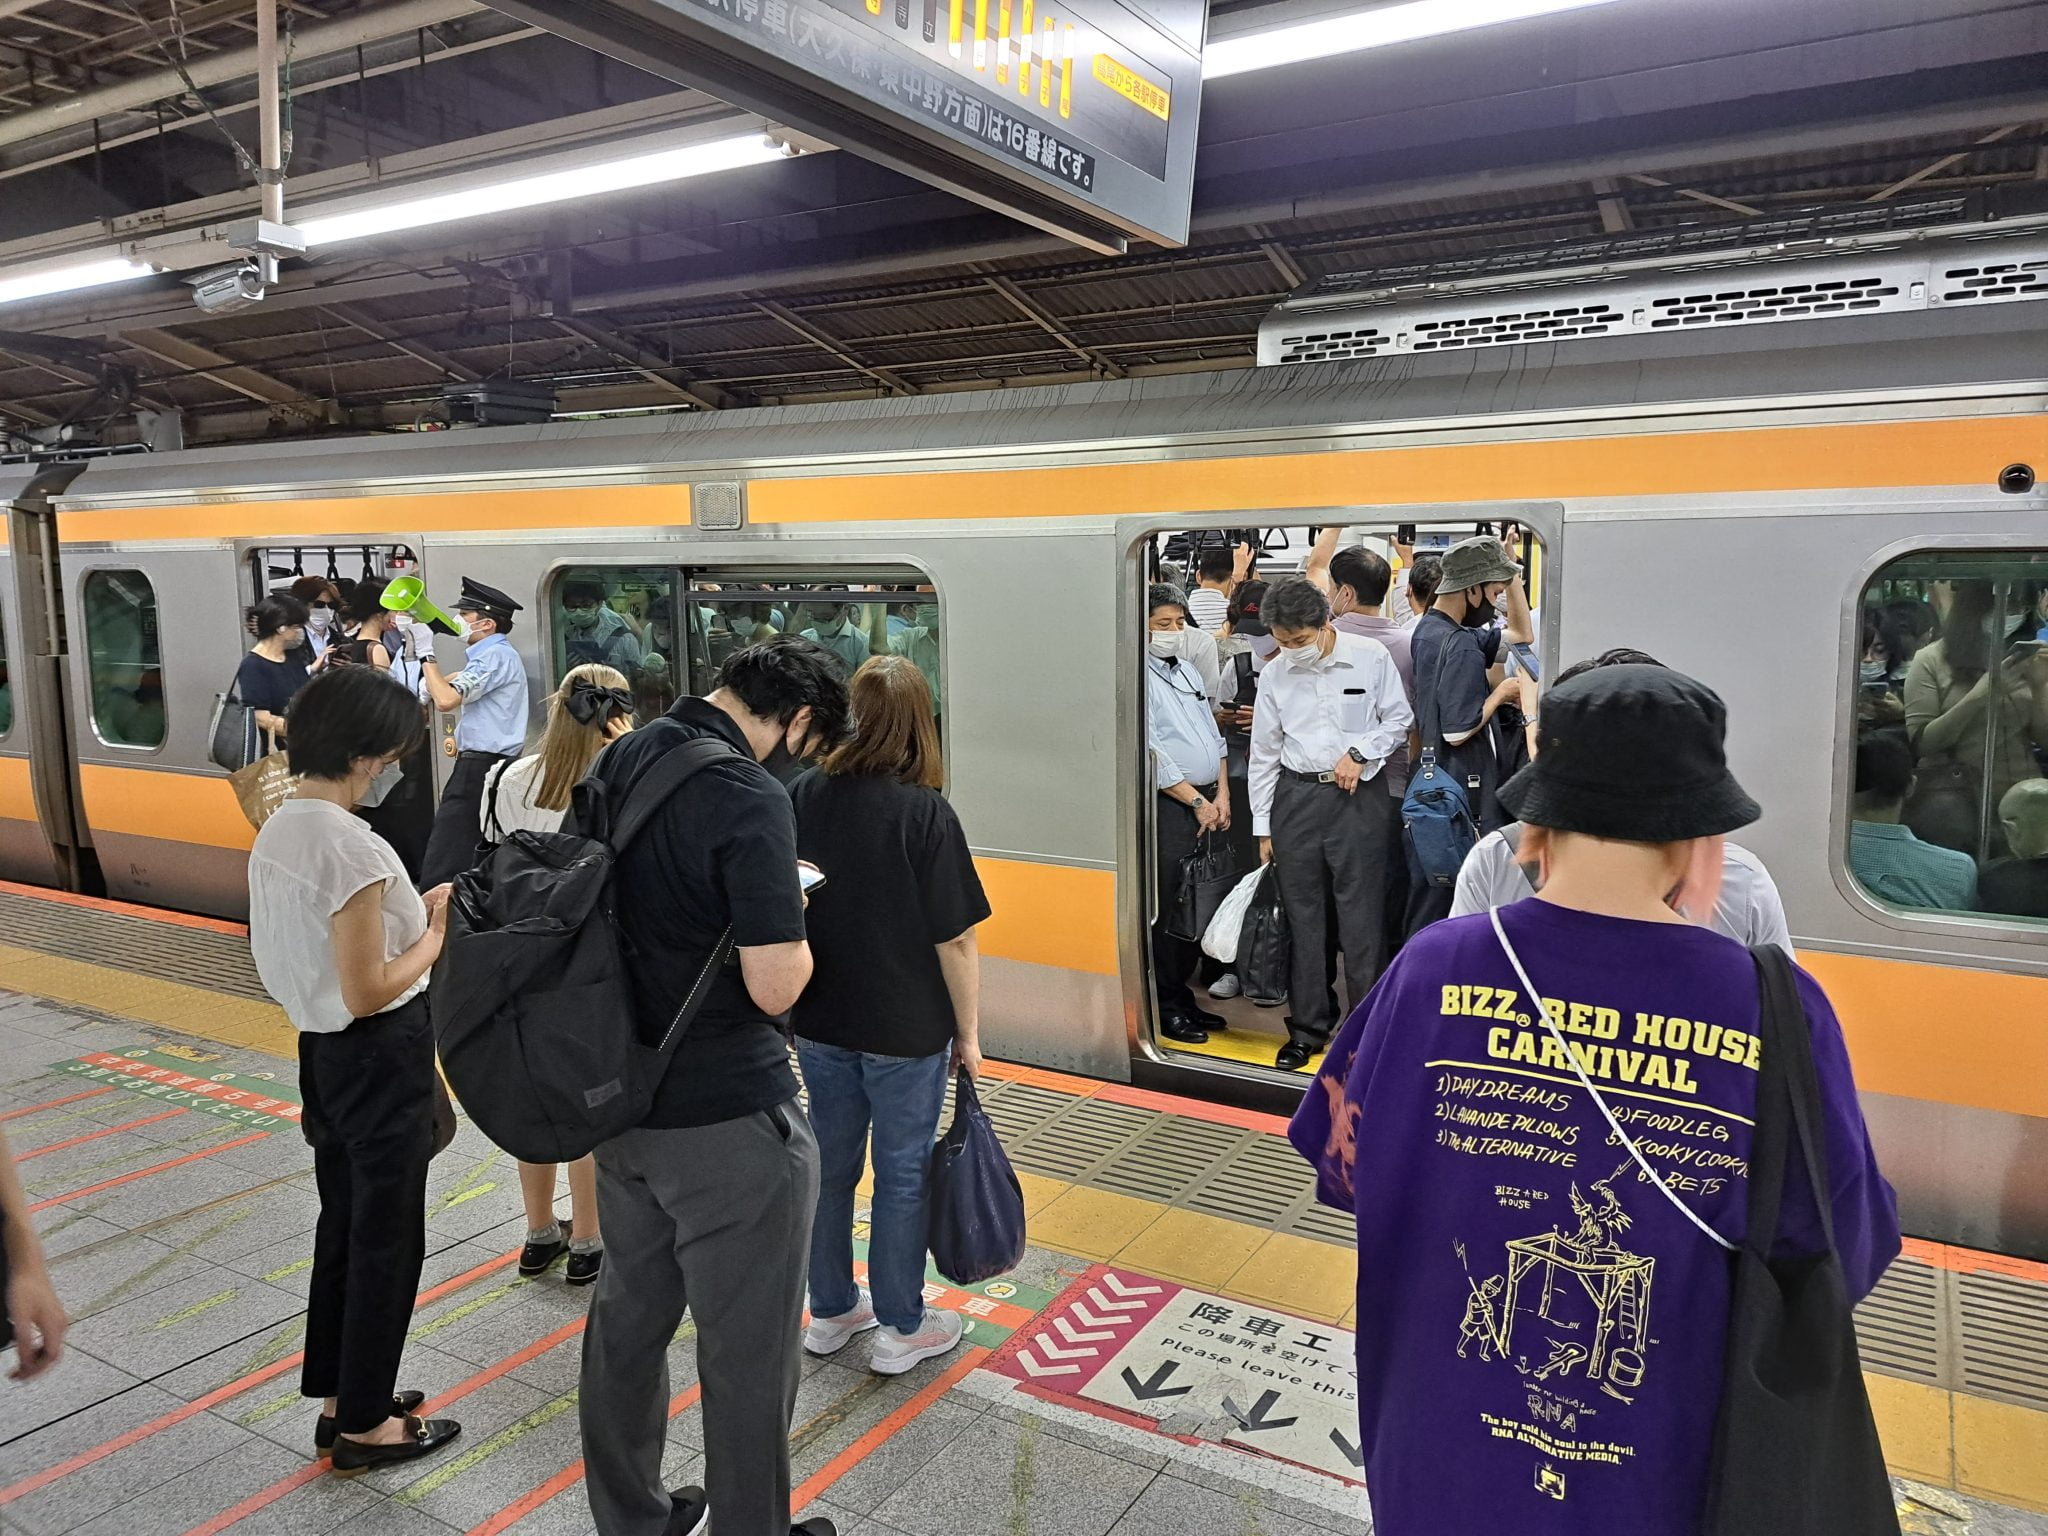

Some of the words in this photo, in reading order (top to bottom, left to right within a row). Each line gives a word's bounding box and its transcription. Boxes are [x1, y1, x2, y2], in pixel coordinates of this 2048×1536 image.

[1440, 984, 1517, 1021] BIZZ
[1538, 997, 1620, 1040] RED
[1632, 1012, 1762, 1071] HOUSE
[1487, 1027, 1697, 1094] CARNIVAL
[1498, 1197, 1532, 1209] HOUSE
[1160, 1338, 1232, 1364] Please
[1241, 1360, 1302, 1385] leave
[1312, 1381, 1356, 1400] this
[1480, 1412, 1499, 1425] The
[1502, 1418, 1519, 1430] boy
[1521, 1421, 1539, 1435] sold
[1540, 1429, 1552, 1443] his
[1554, 1439, 1576, 1450] soul
[1578, 1441, 1588, 1450] to
[1590, 1441, 1605, 1450] the
[1491, 1427, 1513, 1439] RNA
[1516, 1431, 1583, 1461] ALTERNATIVE
